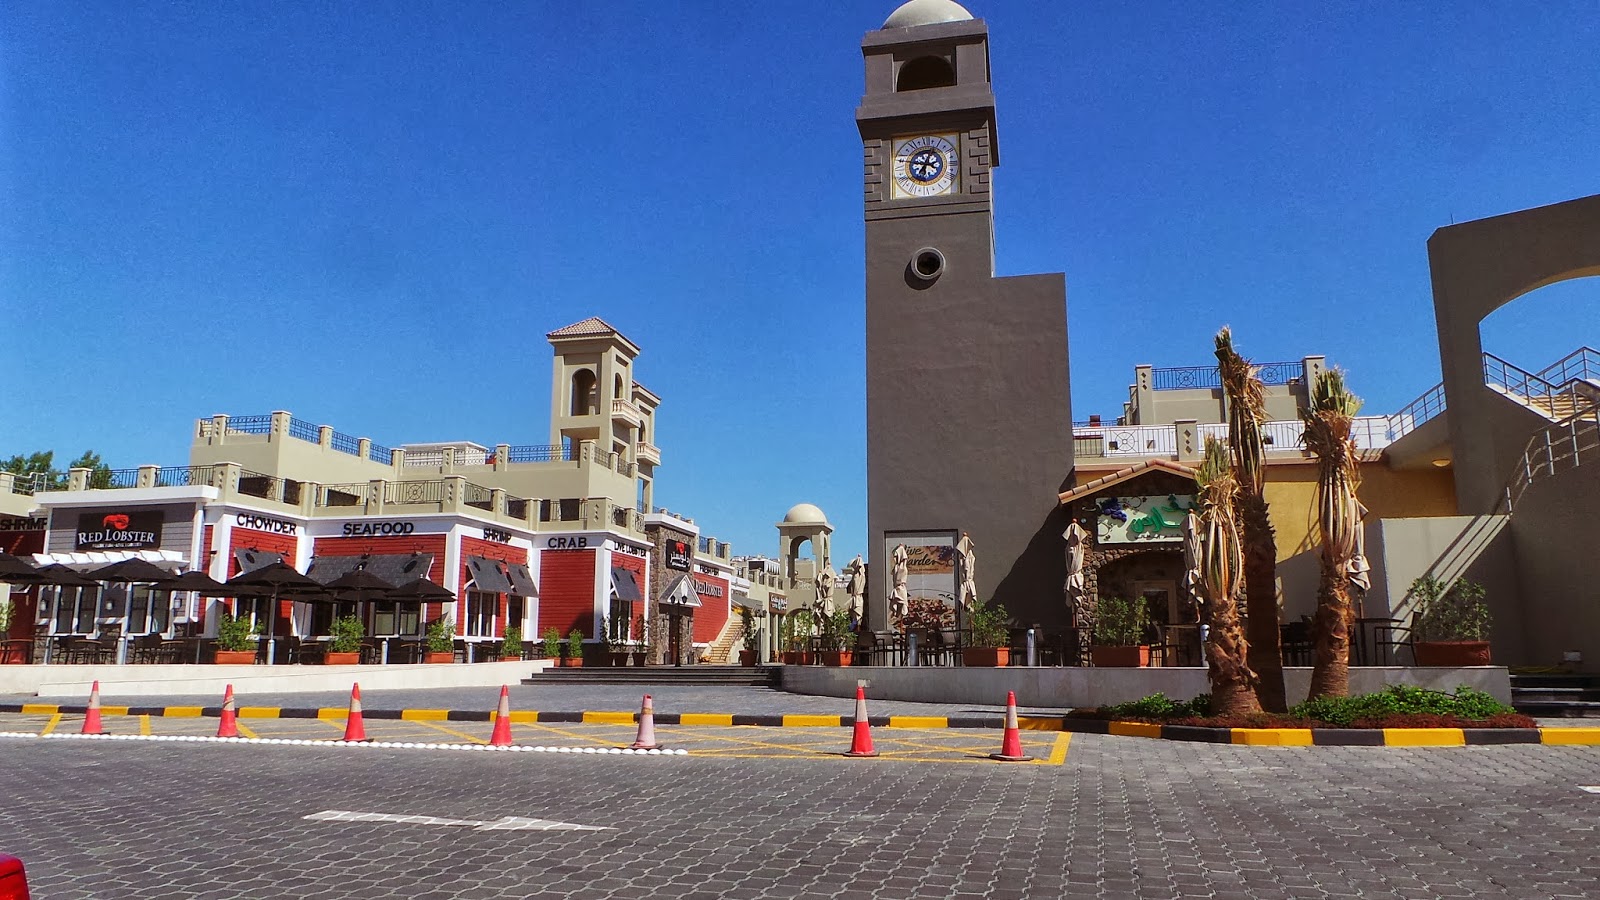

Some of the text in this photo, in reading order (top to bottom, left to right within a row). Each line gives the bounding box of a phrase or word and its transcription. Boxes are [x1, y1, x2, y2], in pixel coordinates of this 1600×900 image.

[236, 513, 297, 536] CHOWDER
[342, 522, 415, 536] SEAFOOD
[78, 528, 155, 545] RED LOBSTER
[483, 527, 512, 544] SHRIMP
[547, 537, 588, 549] CRAB
[905, 553, 945, 566] arden
